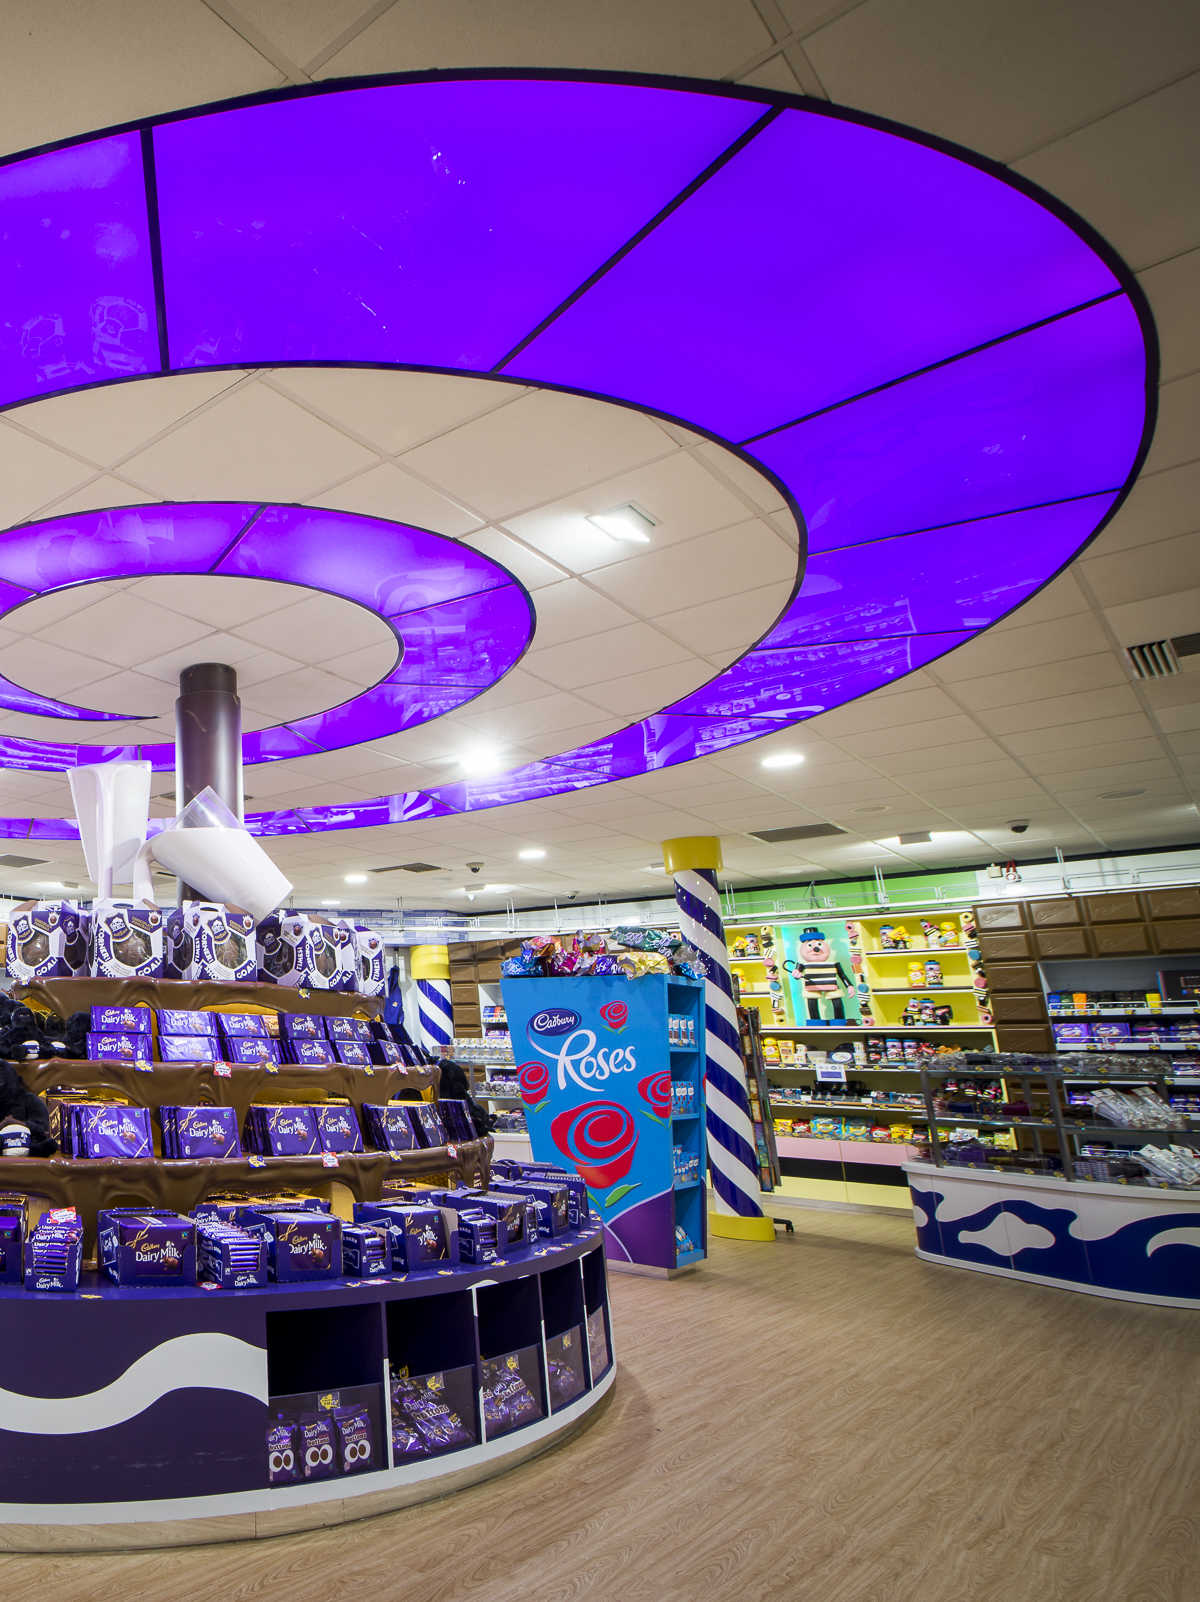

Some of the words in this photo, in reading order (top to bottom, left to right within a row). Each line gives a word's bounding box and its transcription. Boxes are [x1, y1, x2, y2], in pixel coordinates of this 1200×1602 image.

[102, 1014, 120, 1024] Dairy
[534, 1013, 575, 1031] Cadbury
[98, 1042, 117, 1052] Dairy
[557, 1029, 637, 1092] Roses
[99, 1126, 118, 1137] Dairy
[189, 1127, 209, 1138] Dairy
[136, 1251, 160, 1263] Dairy
